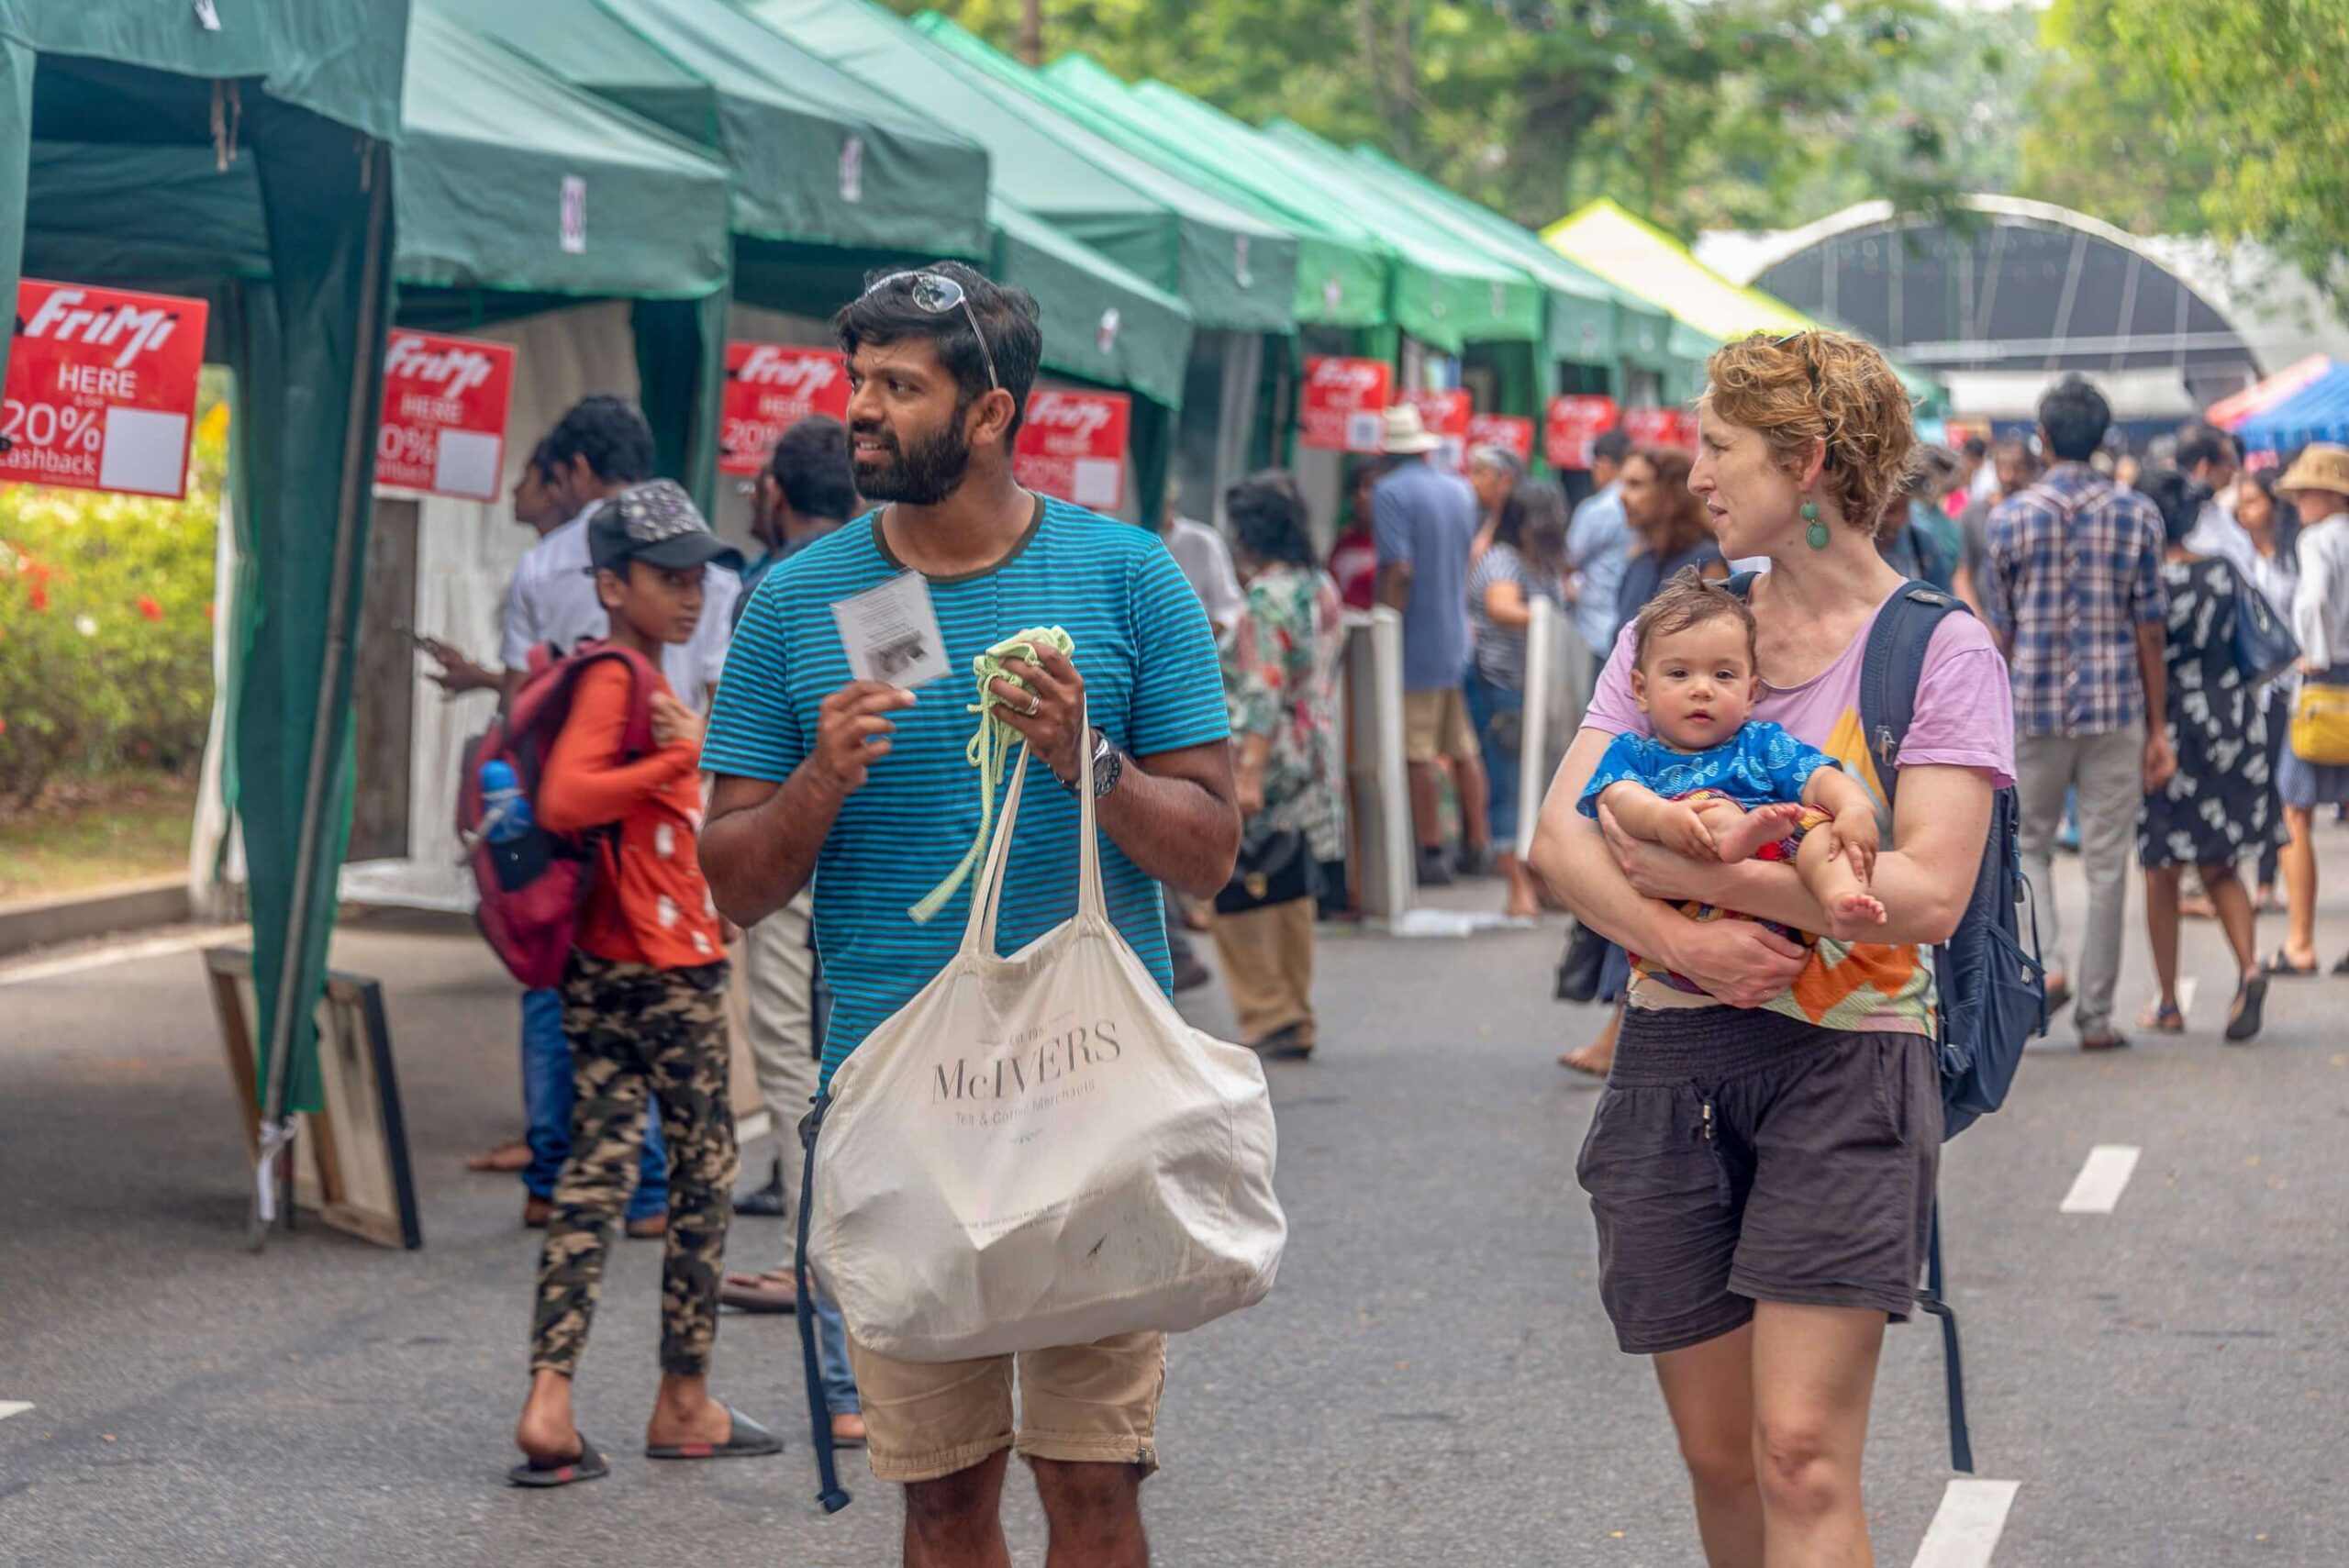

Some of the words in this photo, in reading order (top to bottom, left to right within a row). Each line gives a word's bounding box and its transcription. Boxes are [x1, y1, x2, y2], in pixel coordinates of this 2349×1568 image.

[24, 288, 180, 370] FriMi
[58, 362, 137, 399] HERE
[2, 398, 101, 452] 20%
[401, 393, 462, 425] HERE
[932, 1019, 1121, 1105] McIVERS
[979, 1114, 988, 1127] &
